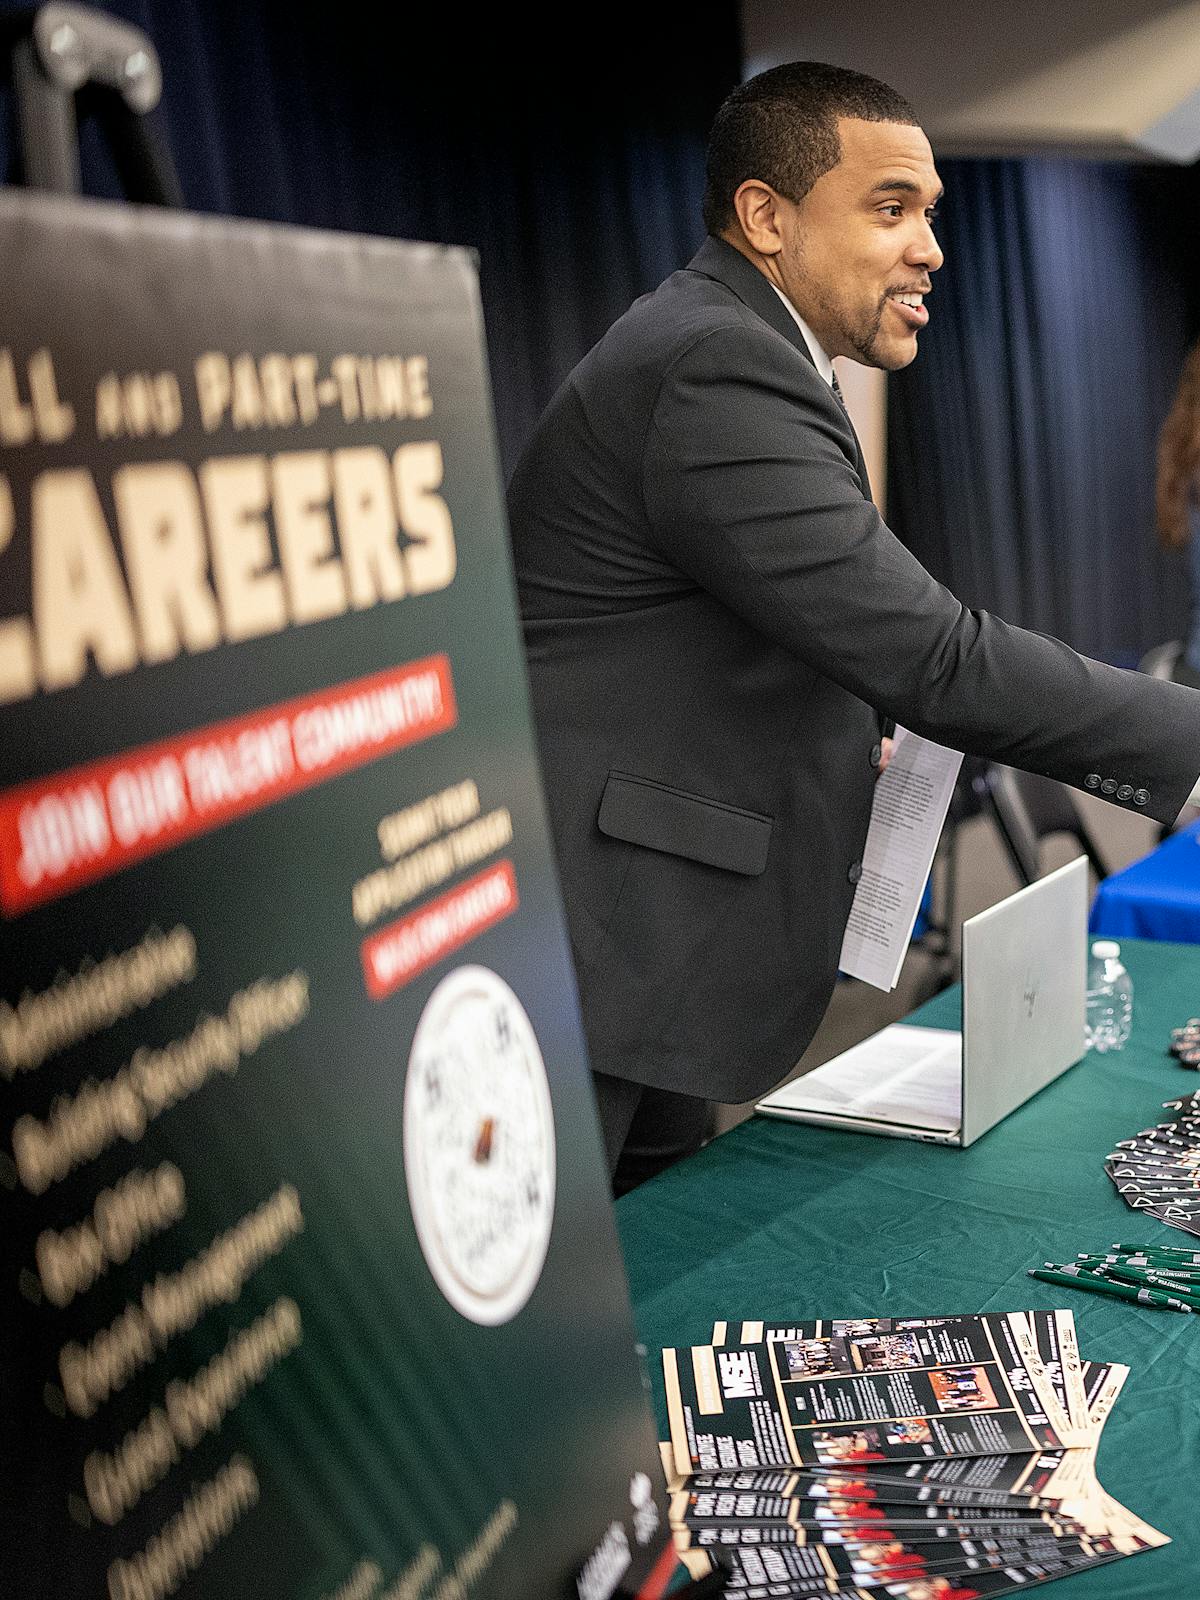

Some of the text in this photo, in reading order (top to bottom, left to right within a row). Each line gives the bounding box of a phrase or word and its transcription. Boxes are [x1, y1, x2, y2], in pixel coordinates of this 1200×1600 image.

[195, 351, 433, 433] PART-TIME
[17, 780, 109, 889] JOIN
[106, 757, 189, 847] OUR
[180, 718, 296, 810] TALENT
